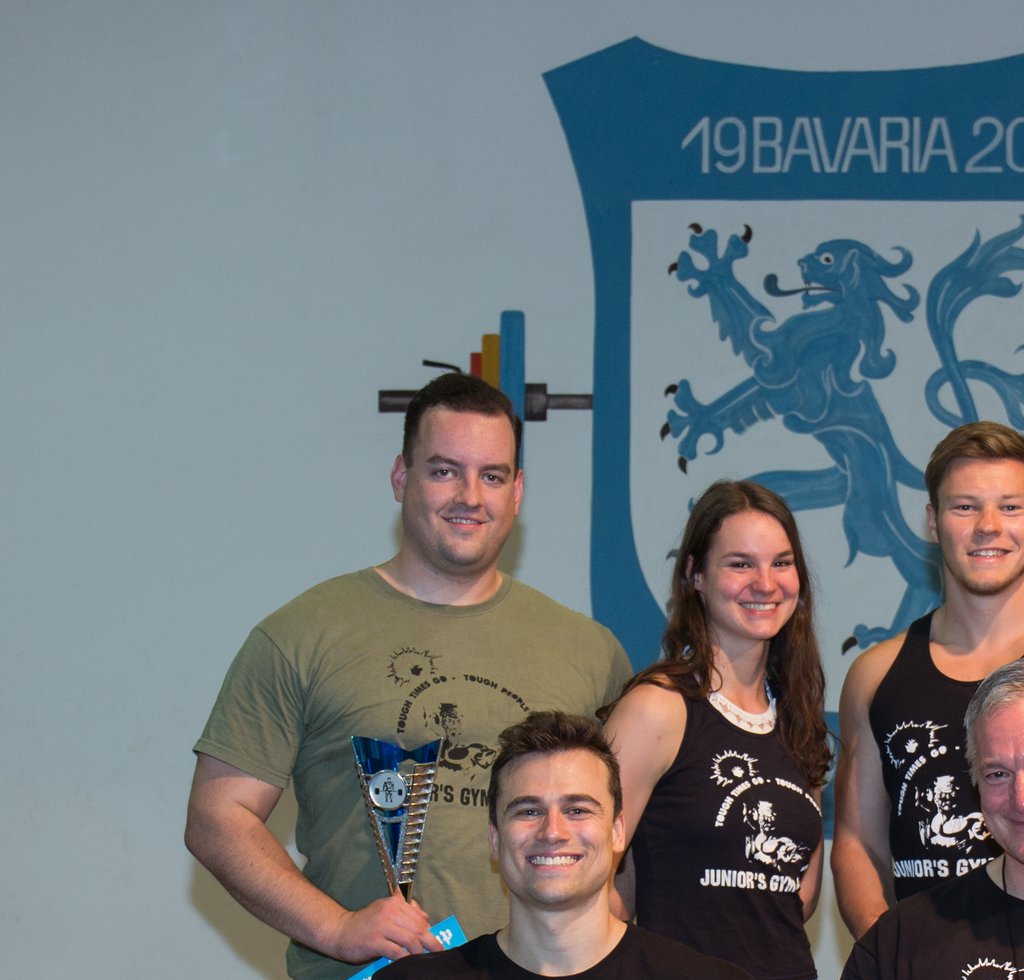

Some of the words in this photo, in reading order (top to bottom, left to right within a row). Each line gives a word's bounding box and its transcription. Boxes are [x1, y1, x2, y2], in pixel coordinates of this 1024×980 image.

[396, 700, 413, 734] TOUGH
[409, 681, 430, 699] TIMES
[432, 675, 447, 684] GO
[463, 674, 498, 689] TOUGH
[500, 687, 529, 712] PEOPLE
[904, 755, 927, 780] TIMES
[715, 796, 734, 827] TOUGH
[730, 781, 751, 797] TIMES
[700, 869, 766, 889] JUNIOR'S
